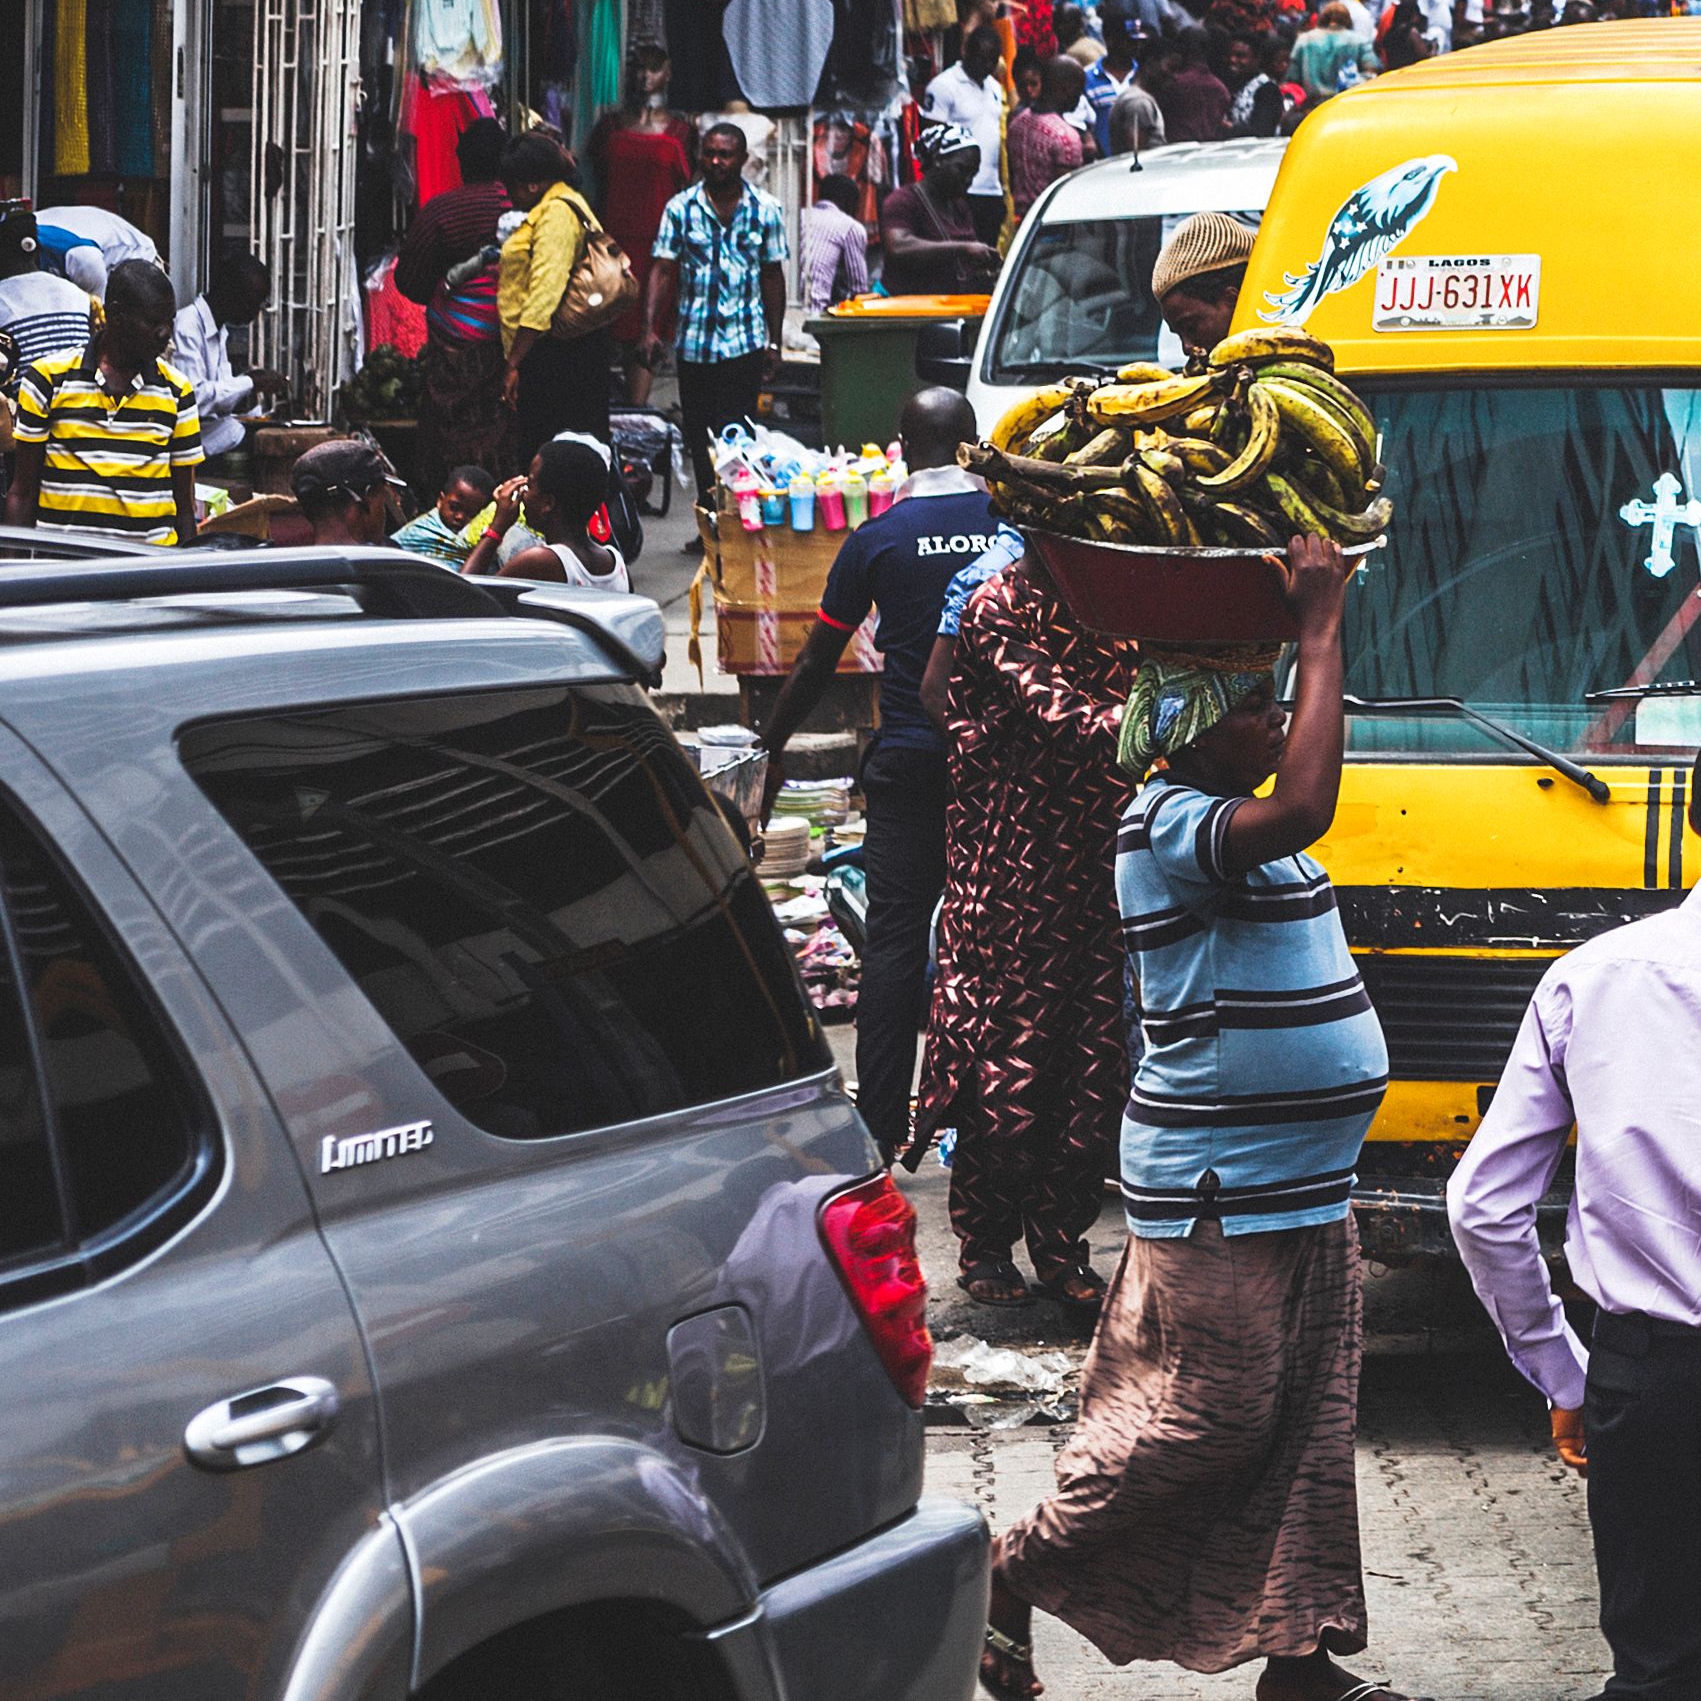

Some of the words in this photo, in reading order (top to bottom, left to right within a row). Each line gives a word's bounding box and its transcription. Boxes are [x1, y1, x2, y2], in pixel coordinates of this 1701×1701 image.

[1428, 258, 1491, 268] LAGOS
[1380, 273, 1533, 311] JJJ-631XK
[321, 1119, 434, 1174] LIMITED
